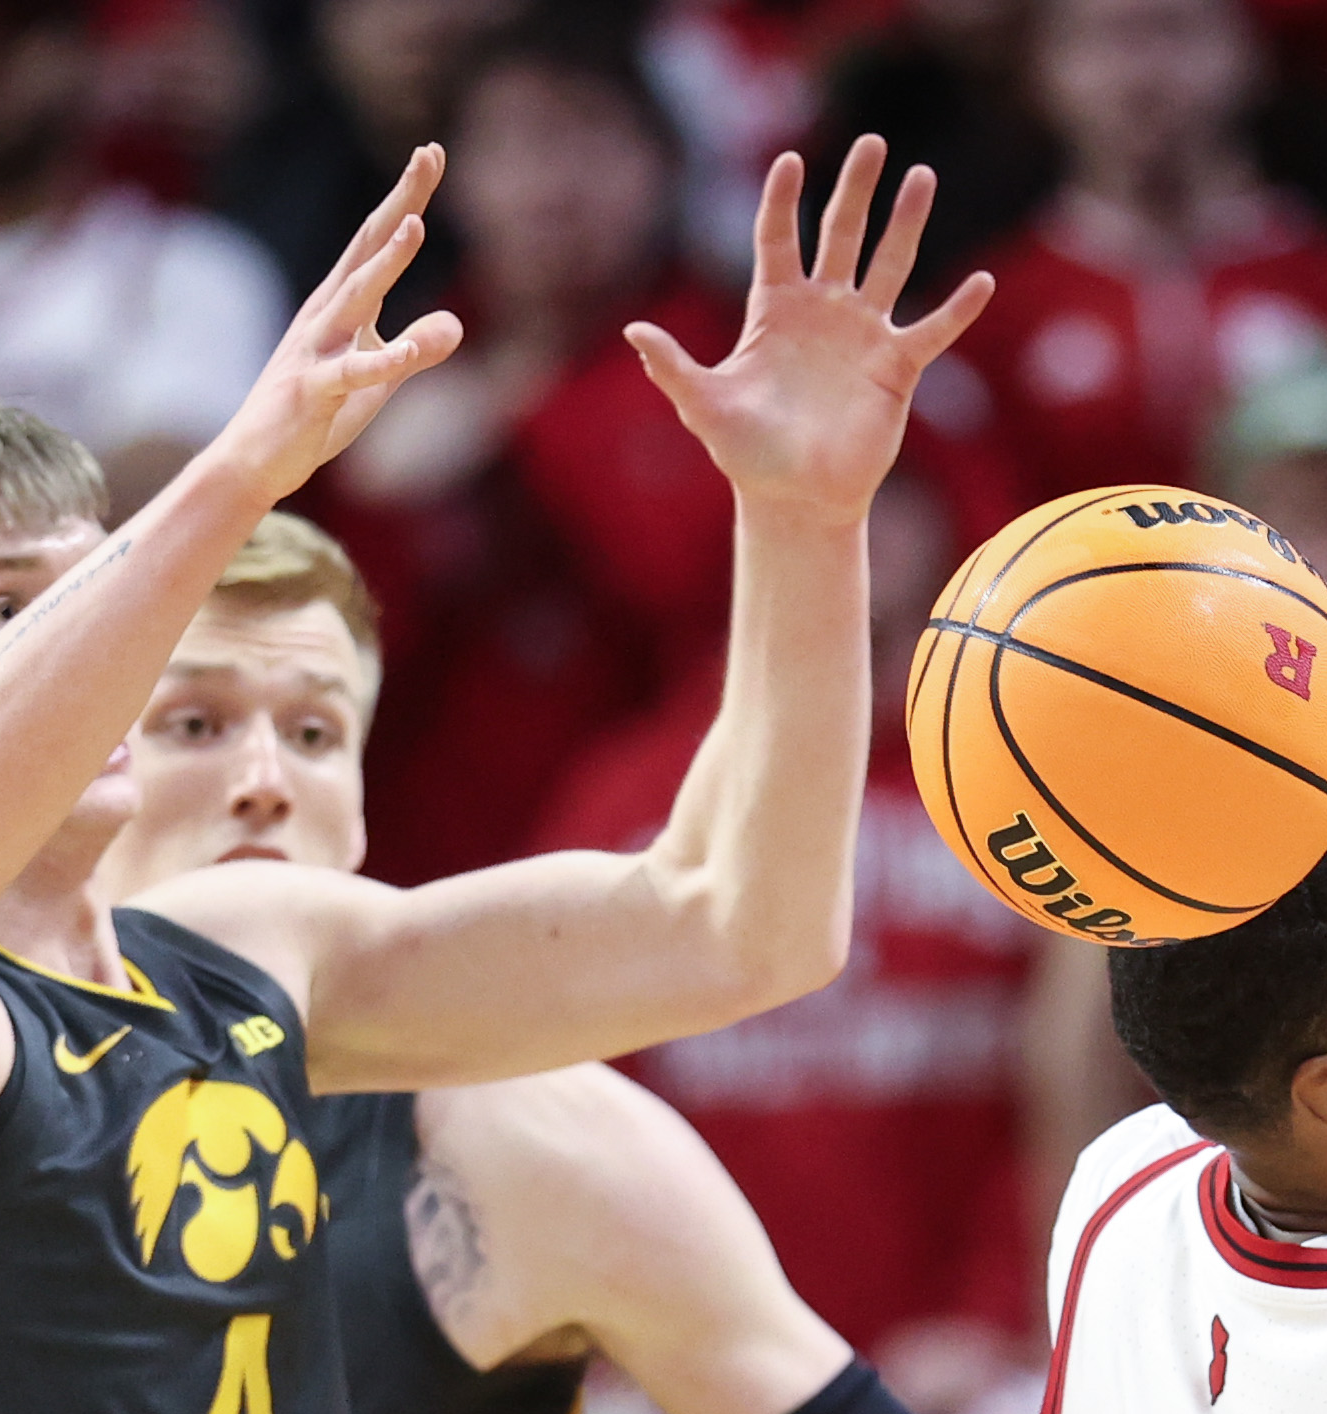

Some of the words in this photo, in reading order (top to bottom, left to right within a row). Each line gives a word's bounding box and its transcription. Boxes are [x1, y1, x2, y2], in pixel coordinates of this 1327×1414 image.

[1118, 501, 1323, 578] lson
[1265, 622, 1317, 701] R
[987, 811, 1173, 946] Wils
